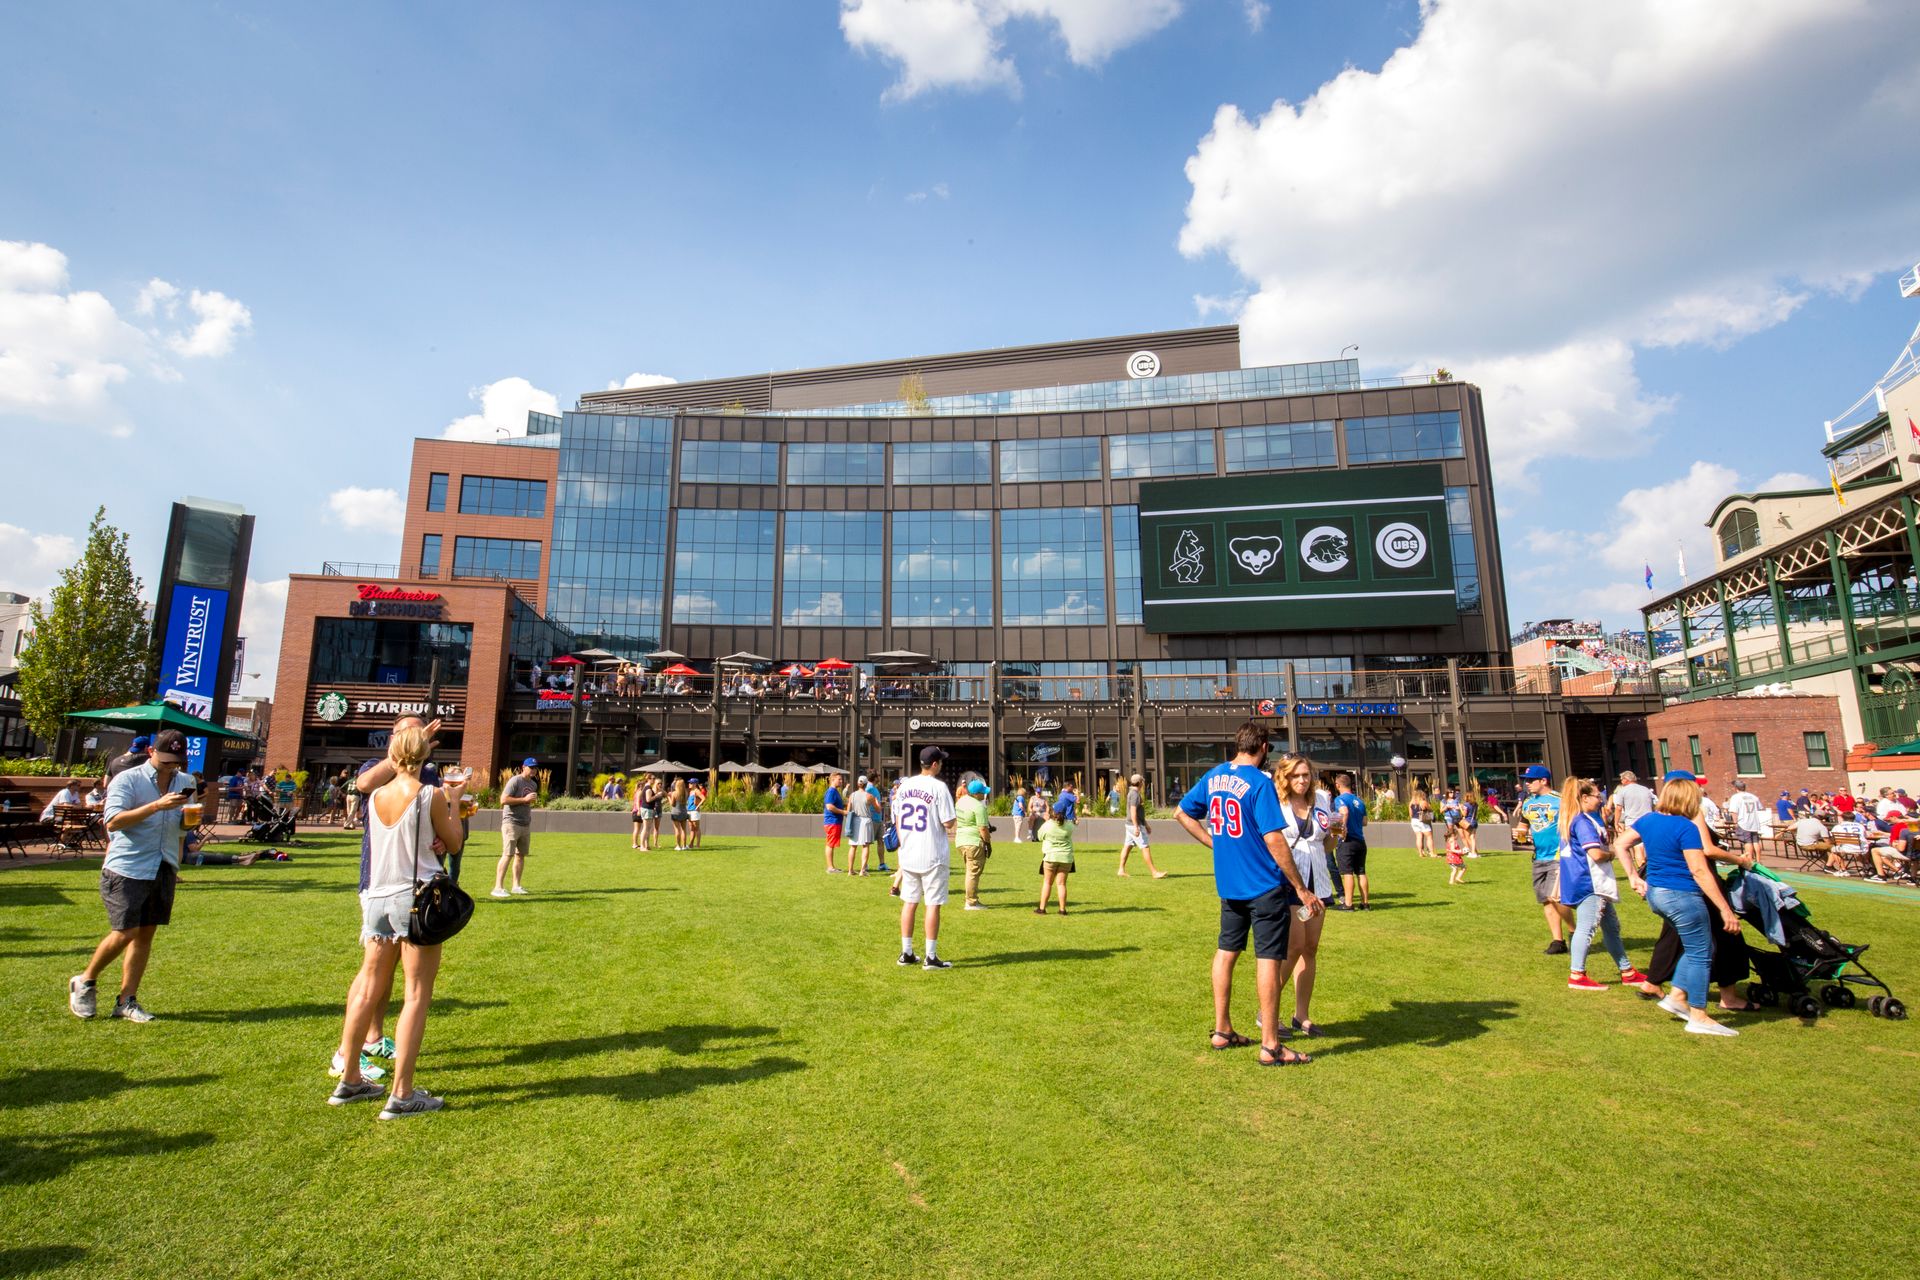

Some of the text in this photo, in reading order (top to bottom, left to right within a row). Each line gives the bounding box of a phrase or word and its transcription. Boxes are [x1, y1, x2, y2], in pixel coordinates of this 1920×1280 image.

[1382, 527, 1420, 562] CUBS
[356, 584, 441, 601] Budweiser
[175, 594, 207, 687] WINTRUST
[1335, 703, 1398, 715] STORE
[920, 720, 951, 728] motorola
[952, 720, 974, 729] trophy
[902, 788, 934, 804] SANDBERG
[900, 803, 928, 832] 23
[1210, 795, 1243, 839] 49
